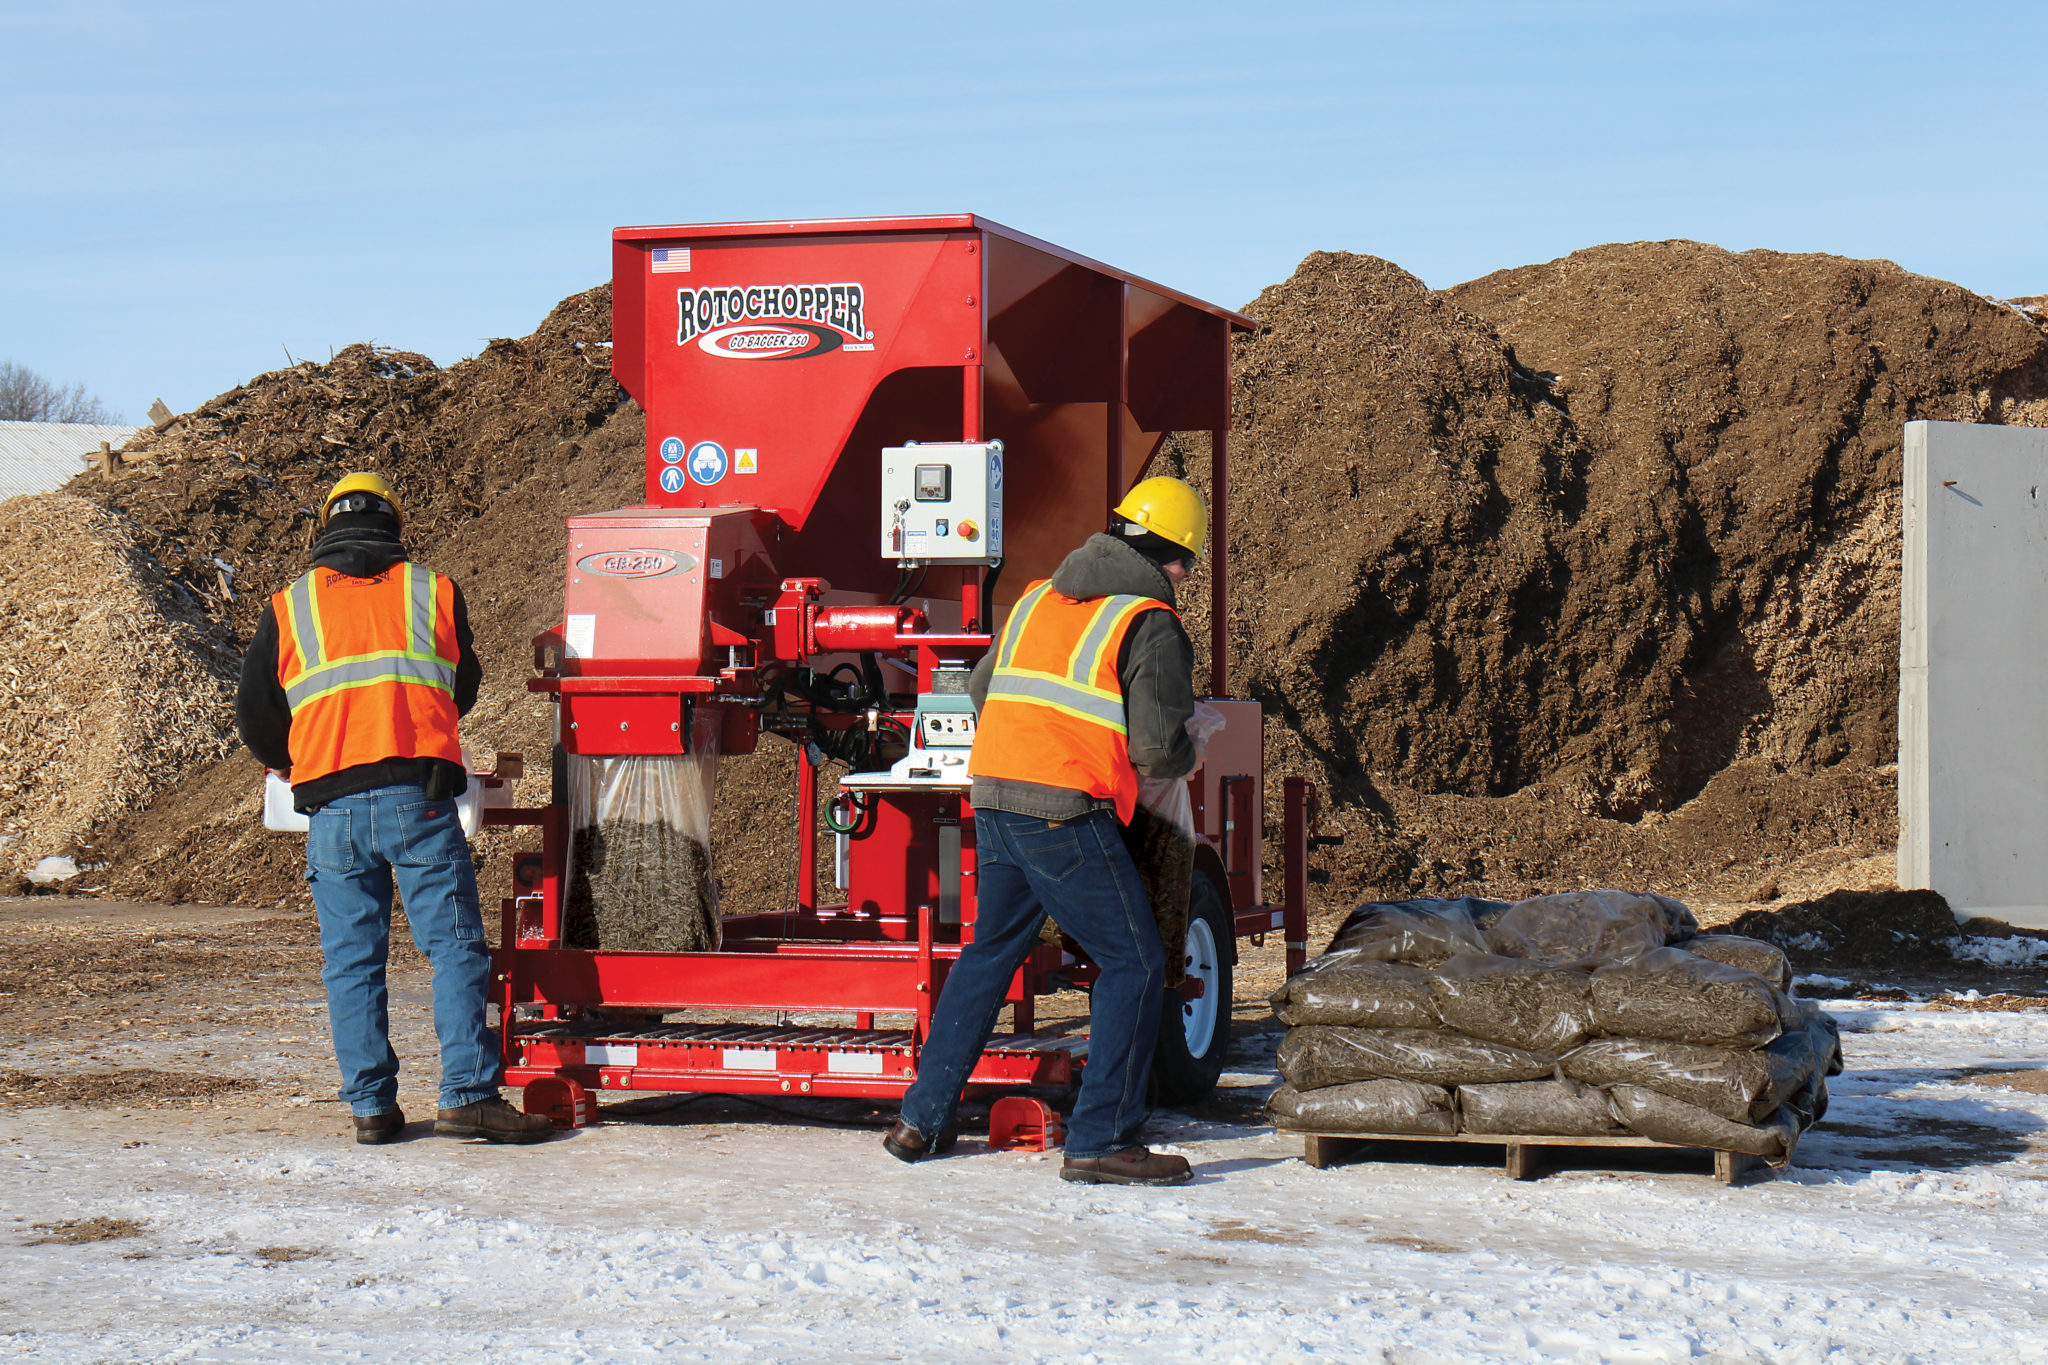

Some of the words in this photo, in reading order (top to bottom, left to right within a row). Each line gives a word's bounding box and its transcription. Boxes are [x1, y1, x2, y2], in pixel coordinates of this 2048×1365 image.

[678, 284, 864, 345] ROTOCHOPPER
[730, 335, 788, 348] GO-BAGGER
[788, 335, 808, 347] 250
[604, 556, 664, 570] GB-250
